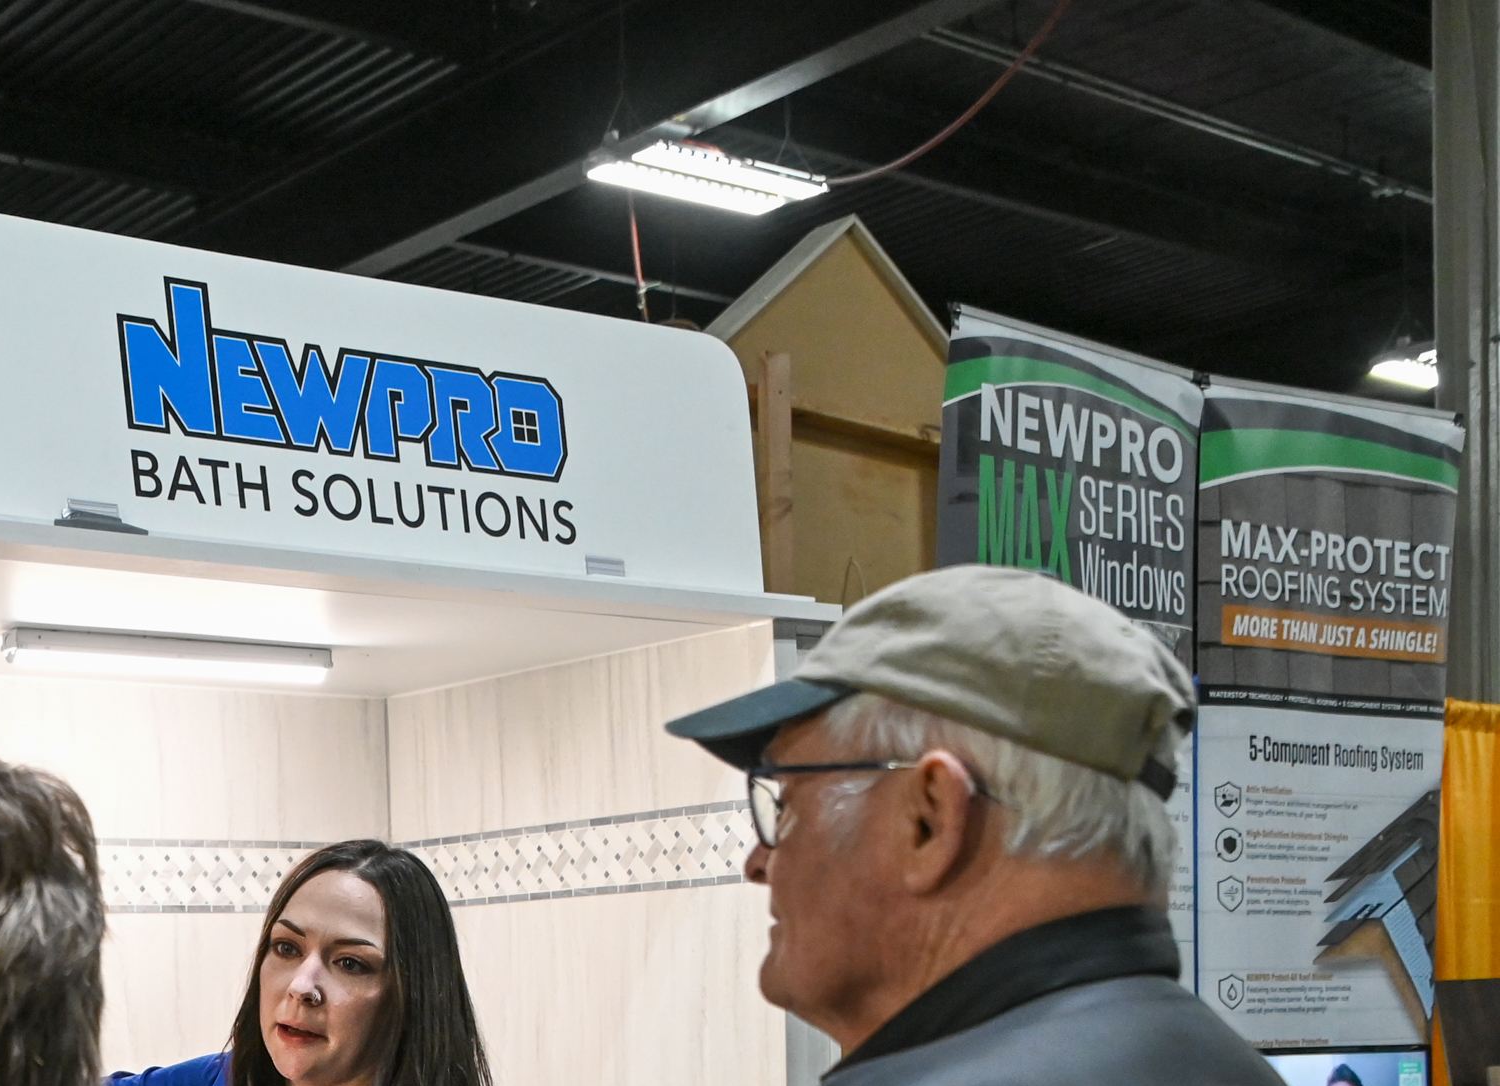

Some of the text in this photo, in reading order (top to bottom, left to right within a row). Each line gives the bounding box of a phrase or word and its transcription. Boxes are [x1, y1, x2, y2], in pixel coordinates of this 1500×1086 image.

[116, 276, 568, 482] NEWPRO
[980, 382, 1183, 484] NEWPRO
[130, 449, 577, 545] BATH SOLUTIONS
[977, 453, 1073, 586] MAX
[1079, 475, 1185, 552] SERIES
[1078, 540, 1186, 616] Windows
[1220, 518, 1450, 581] MAX-PROTECT
[1220, 564, 1447, 618] ROOFING SYSTEM
[1232, 614, 1438, 654] MORE THAN JUST A SHINGLE!
[1249, 734, 1424, 772] 5-Component Roofing System
